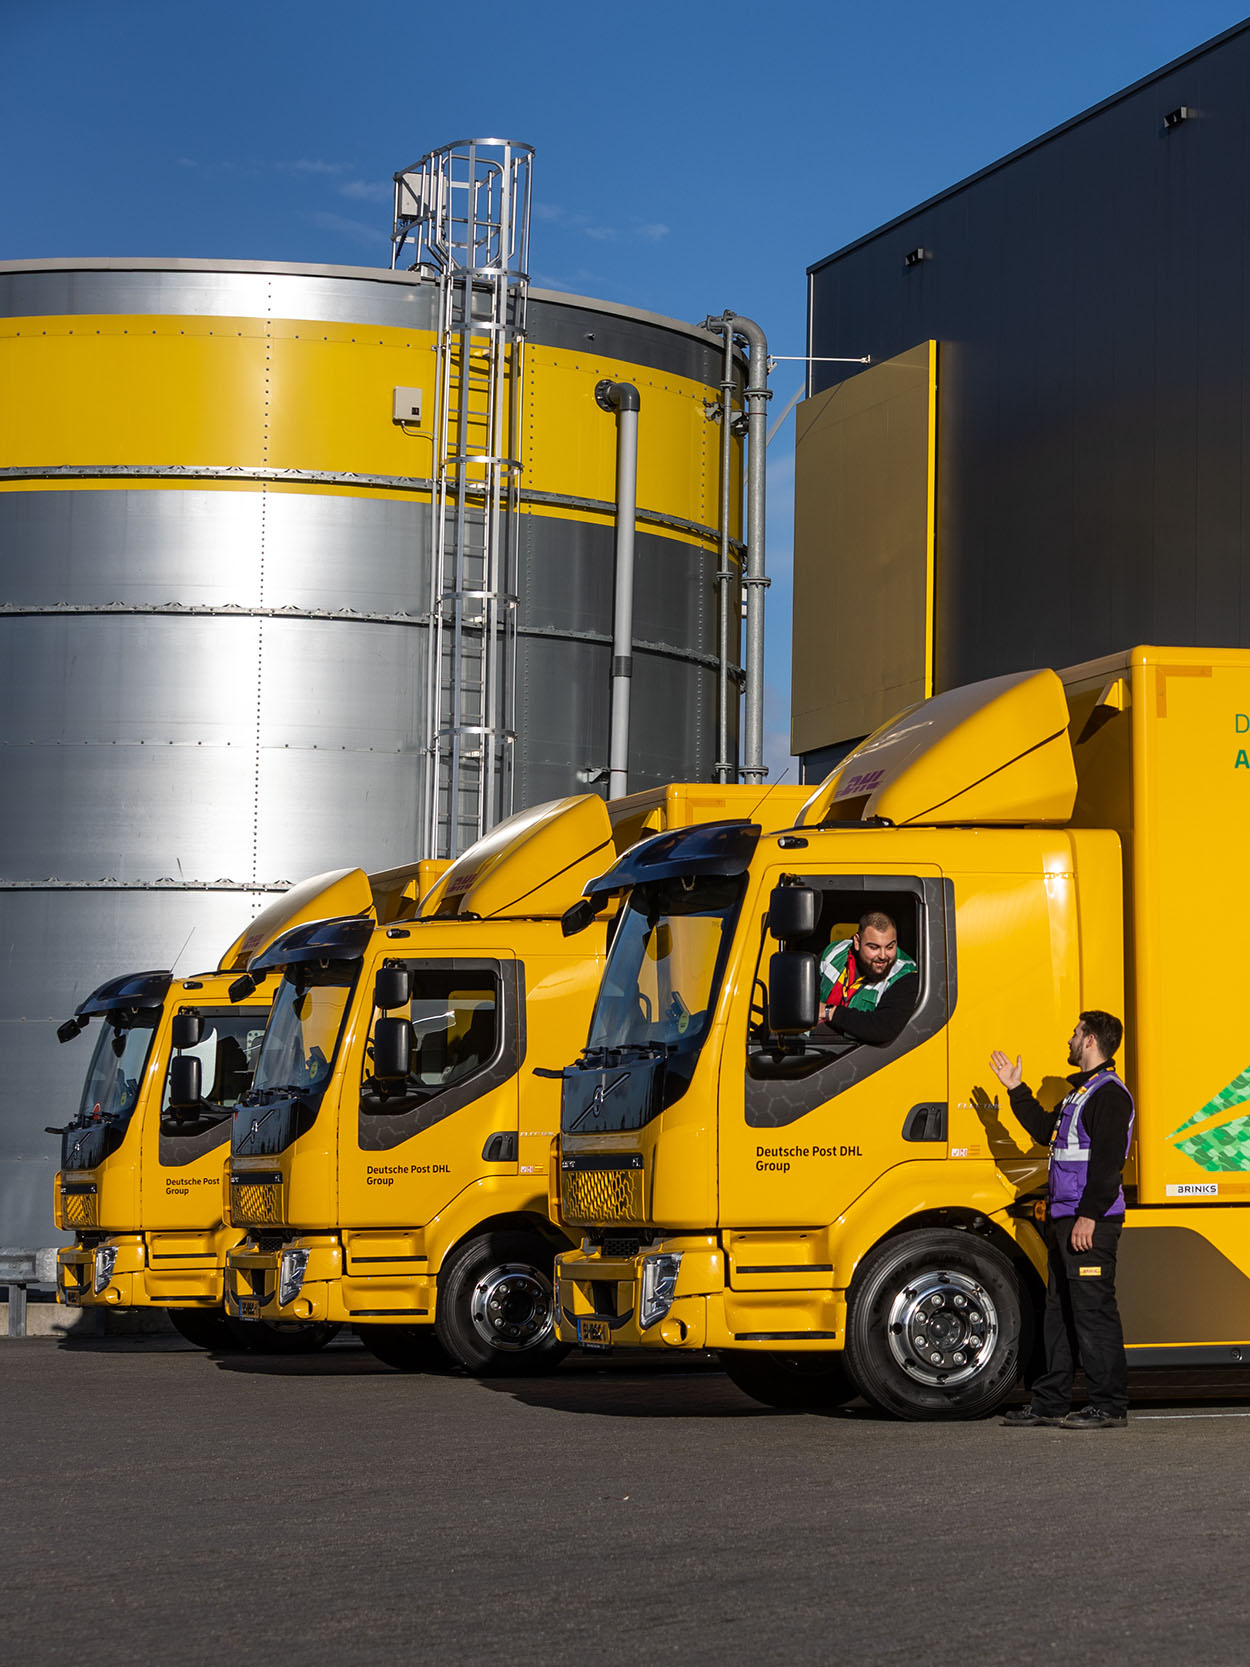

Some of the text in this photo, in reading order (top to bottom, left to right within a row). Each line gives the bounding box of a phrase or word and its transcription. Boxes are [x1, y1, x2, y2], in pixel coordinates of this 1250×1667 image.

[756, 1145, 863, 1157] Deutsche Post DHL
[367, 1164, 451, 1175] Deutsche Post DHL
[756, 1160, 791, 1173] Group
[166, 1178, 202, 1186] Deutsche
[203, 1177, 220, 1185] Post
[366, 1176, 394, 1187] Group
[166, 1187, 190, 1196] Group
[1177, 1184, 1217, 1194] BRINKS
